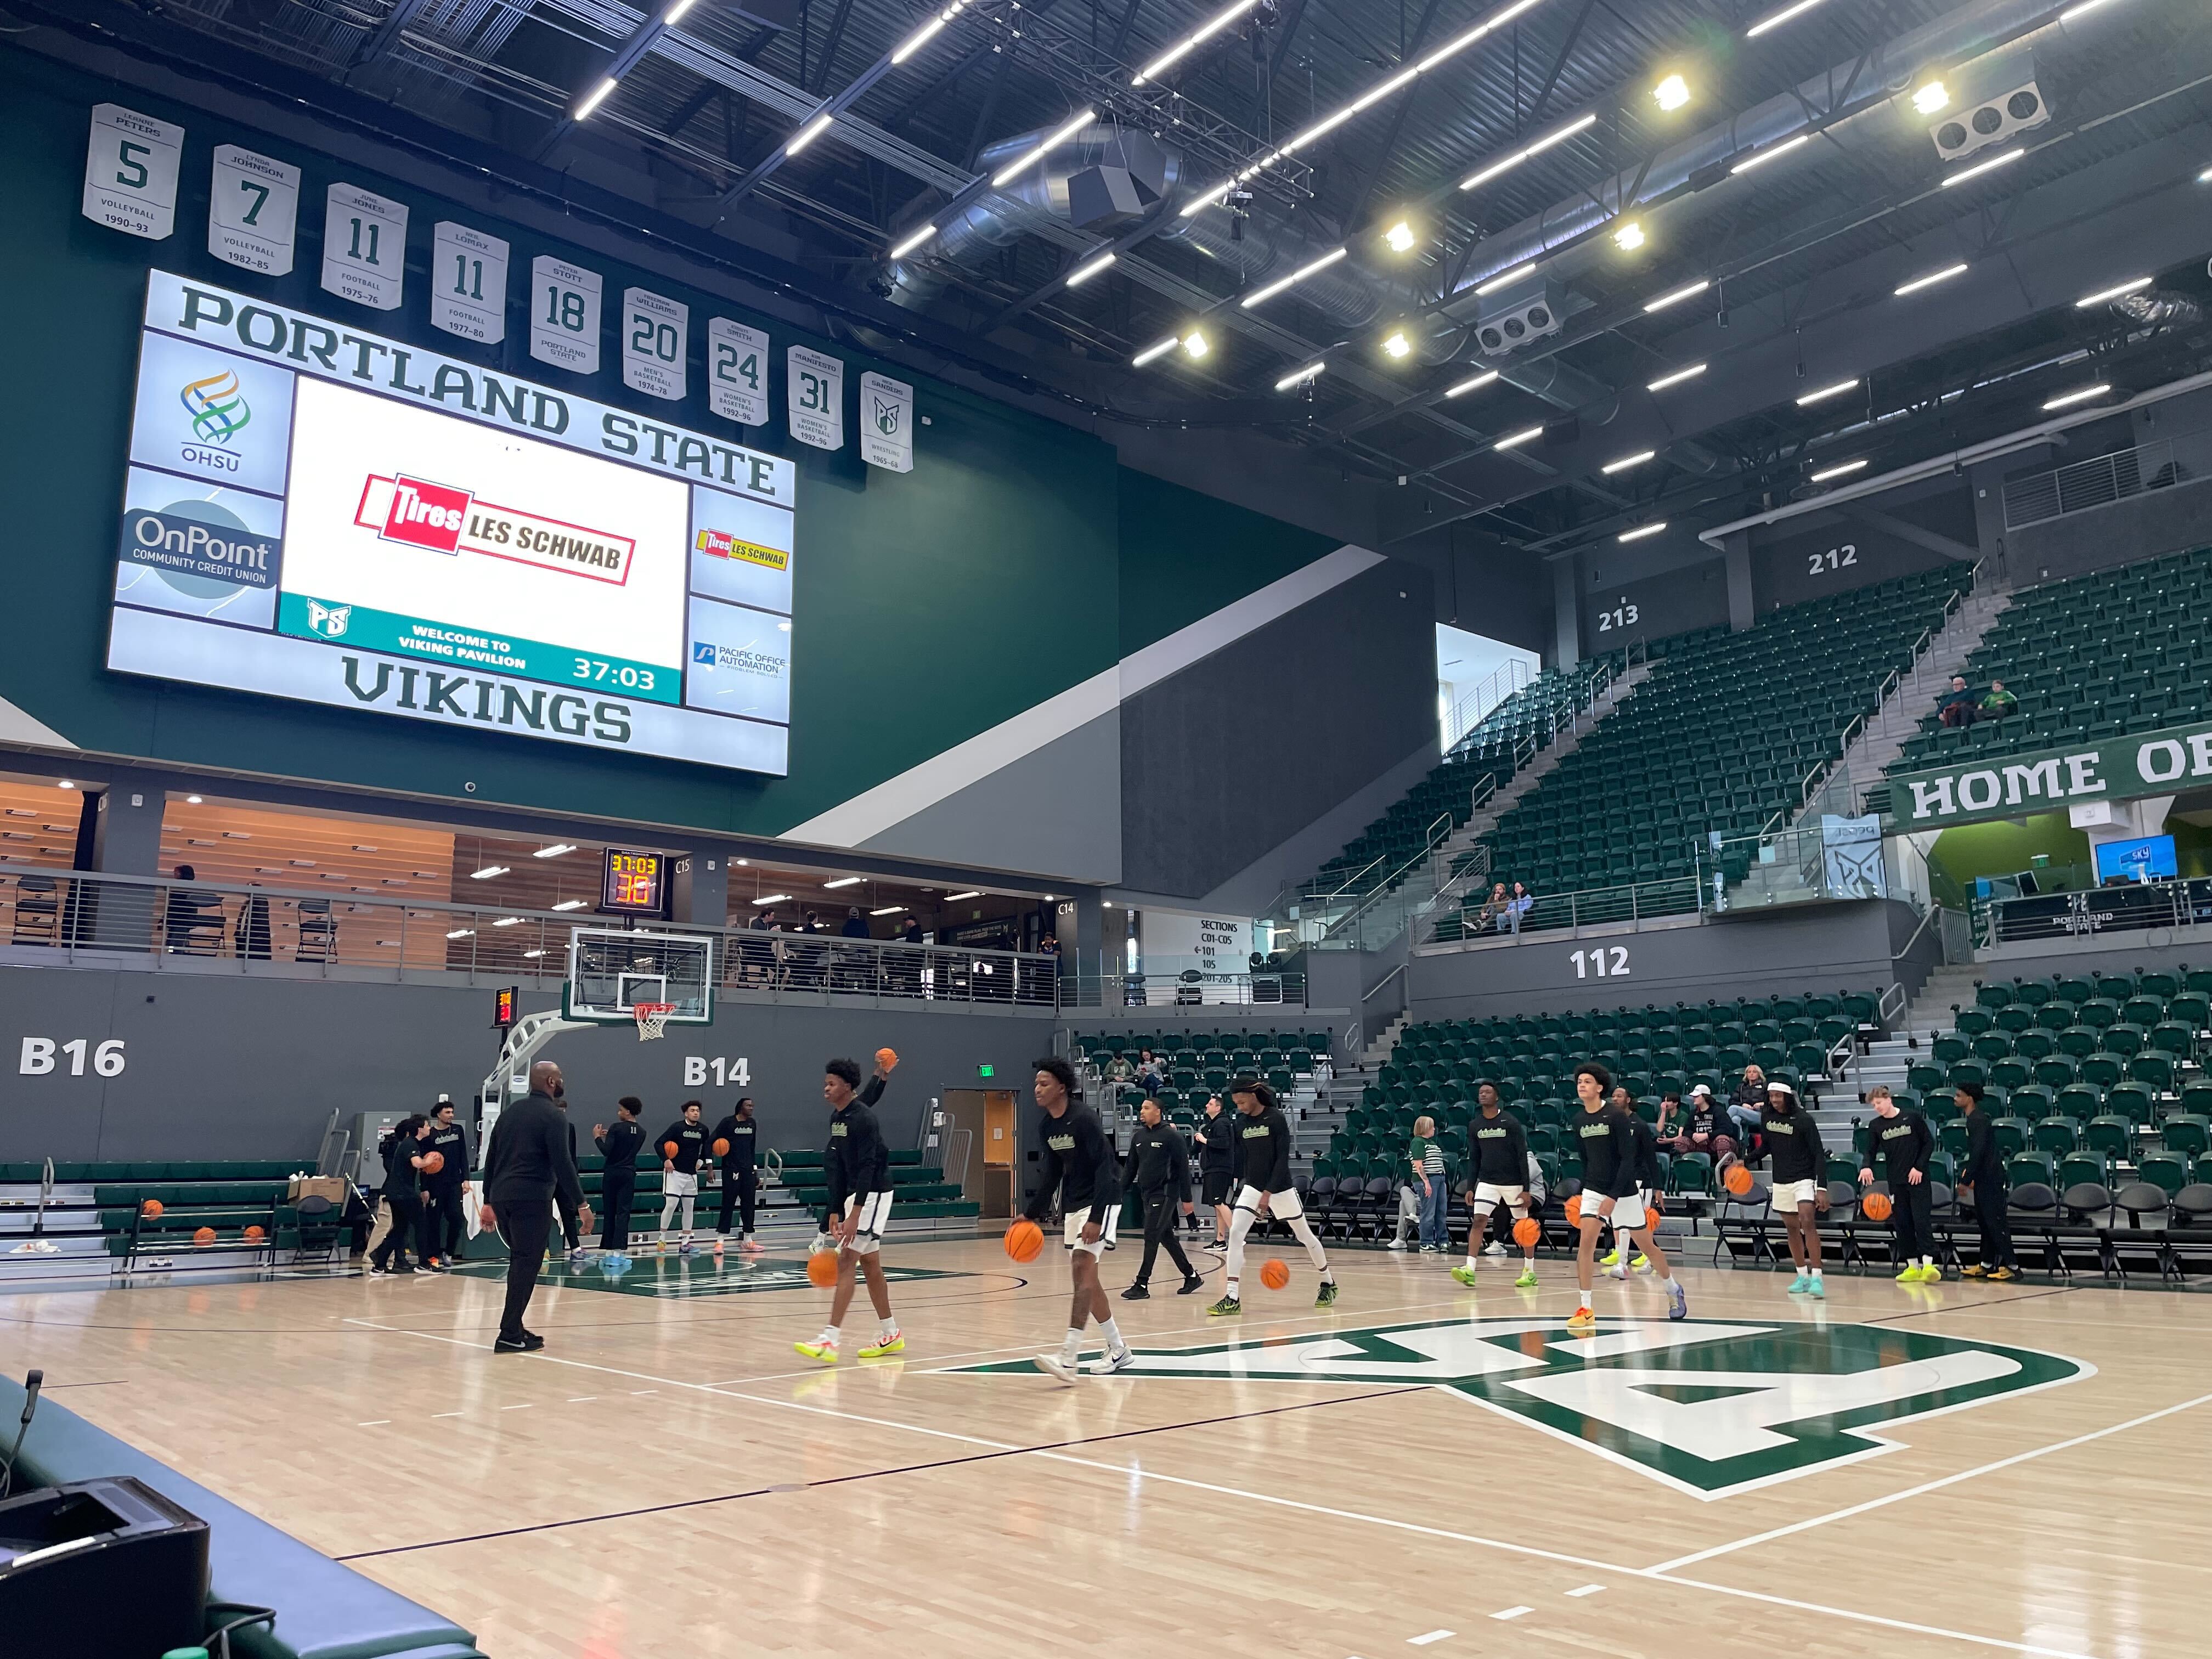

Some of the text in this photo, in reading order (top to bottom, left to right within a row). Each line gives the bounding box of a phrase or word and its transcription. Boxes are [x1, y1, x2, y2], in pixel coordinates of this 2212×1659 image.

[116, 116, 161, 137] PETERS
[116, 139, 150, 189] 5
[231, 156, 284, 179] JOHNSON
[246, 154, 270, 166] LYNDA
[241, 179, 270, 227] 7
[352, 198, 385, 214] JONES
[359, 194, 378, 204] JUNE
[101, 198, 155, 221] VOLLEYBALL
[105, 213, 149, 233] 1990–93
[224, 236, 275, 258] VOLLEYBALL
[347, 218, 380, 266] 11
[455, 233, 489, 251] LOMAX
[228, 251, 269, 270] 1982–85
[341, 273, 381, 291] FOOTBALL
[454, 254, 483, 301] 11
[553, 268, 583, 283] STOTT
[342, 286, 379, 304] 1975–76
[547, 286, 585, 332] 18
[636, 296, 678, 316] WILLIAMS
[449, 308, 486, 325] FOOTBALL
[449, 321, 484, 338] 1977–80
[631, 313, 678, 363] 20
[726, 328, 752, 342] SMITH
[541, 340, 586, 359] PORTLAND
[550, 348, 577, 362] STATE
[644, 366, 663, 378] MEN'S
[716, 342, 759, 391] 24
[795, 352, 837, 373] MANIFESTO
[634, 370, 672, 387] BASKETBALL
[637, 380, 668, 396] 1974–78
[871, 380, 904, 396] SANDERS
[178, 285, 776, 496] PORTLAND STATE
[723, 392, 752, 406] WOMEN'S
[799, 371, 830, 415] 31
[719, 397, 755, 413] BASKETBALL
[723, 407, 752, 421] 1992–96
[797, 422, 830, 438] BASKETBALL
[801, 417, 827, 430] WOMEN'S
[800, 432, 827, 445] 1992–96
[182, 447, 239, 472] OHSU
[871, 444, 900, 458] WRESTLING
[873, 455, 898, 468] 1965–68
[398, 484, 621, 571] Tires LES SCHWAB
[136, 516, 268, 571] OnPoint
[708, 532, 785, 565] Tires LES SCHWAB
[133, 548, 266, 584] COMMUNITY CREDIT UNION
[1808, 544, 1858, 575] 212
[1598, 603, 1640, 633] 213
[411, 624, 511, 653] WELCOME TO
[398, 636, 526, 670] VIKING PAVILION
[719, 646, 786, 667] PACIFIC OFFICE
[572, 657, 655, 691] 37:03
[719, 654, 779, 674] AUTOMATION
[341, 656, 631, 744] VIKINGS
[1908, 751, 2107, 820] HOME
[2132, 847, 2149, 860] SKY
[612, 854, 656, 875] 37:03
[675, 858, 690, 874] C15
[616, 872, 650, 904] 30
[1057, 902, 1074, 915] C14
[1201, 920, 1238, 933] SECTIONS
[1201, 933, 1232, 945] C01-C05
[1202, 946, 1215, 956] 101
[1203, 960, 1216, 969] 105
[1570, 946, 1631, 979] 112
[1202, 972, 1232, 984] 201-205
[19, 1036, 126, 1077] B16
[683, 1056, 752, 1087] B14
[981, 1066, 992, 1076] EXIT
